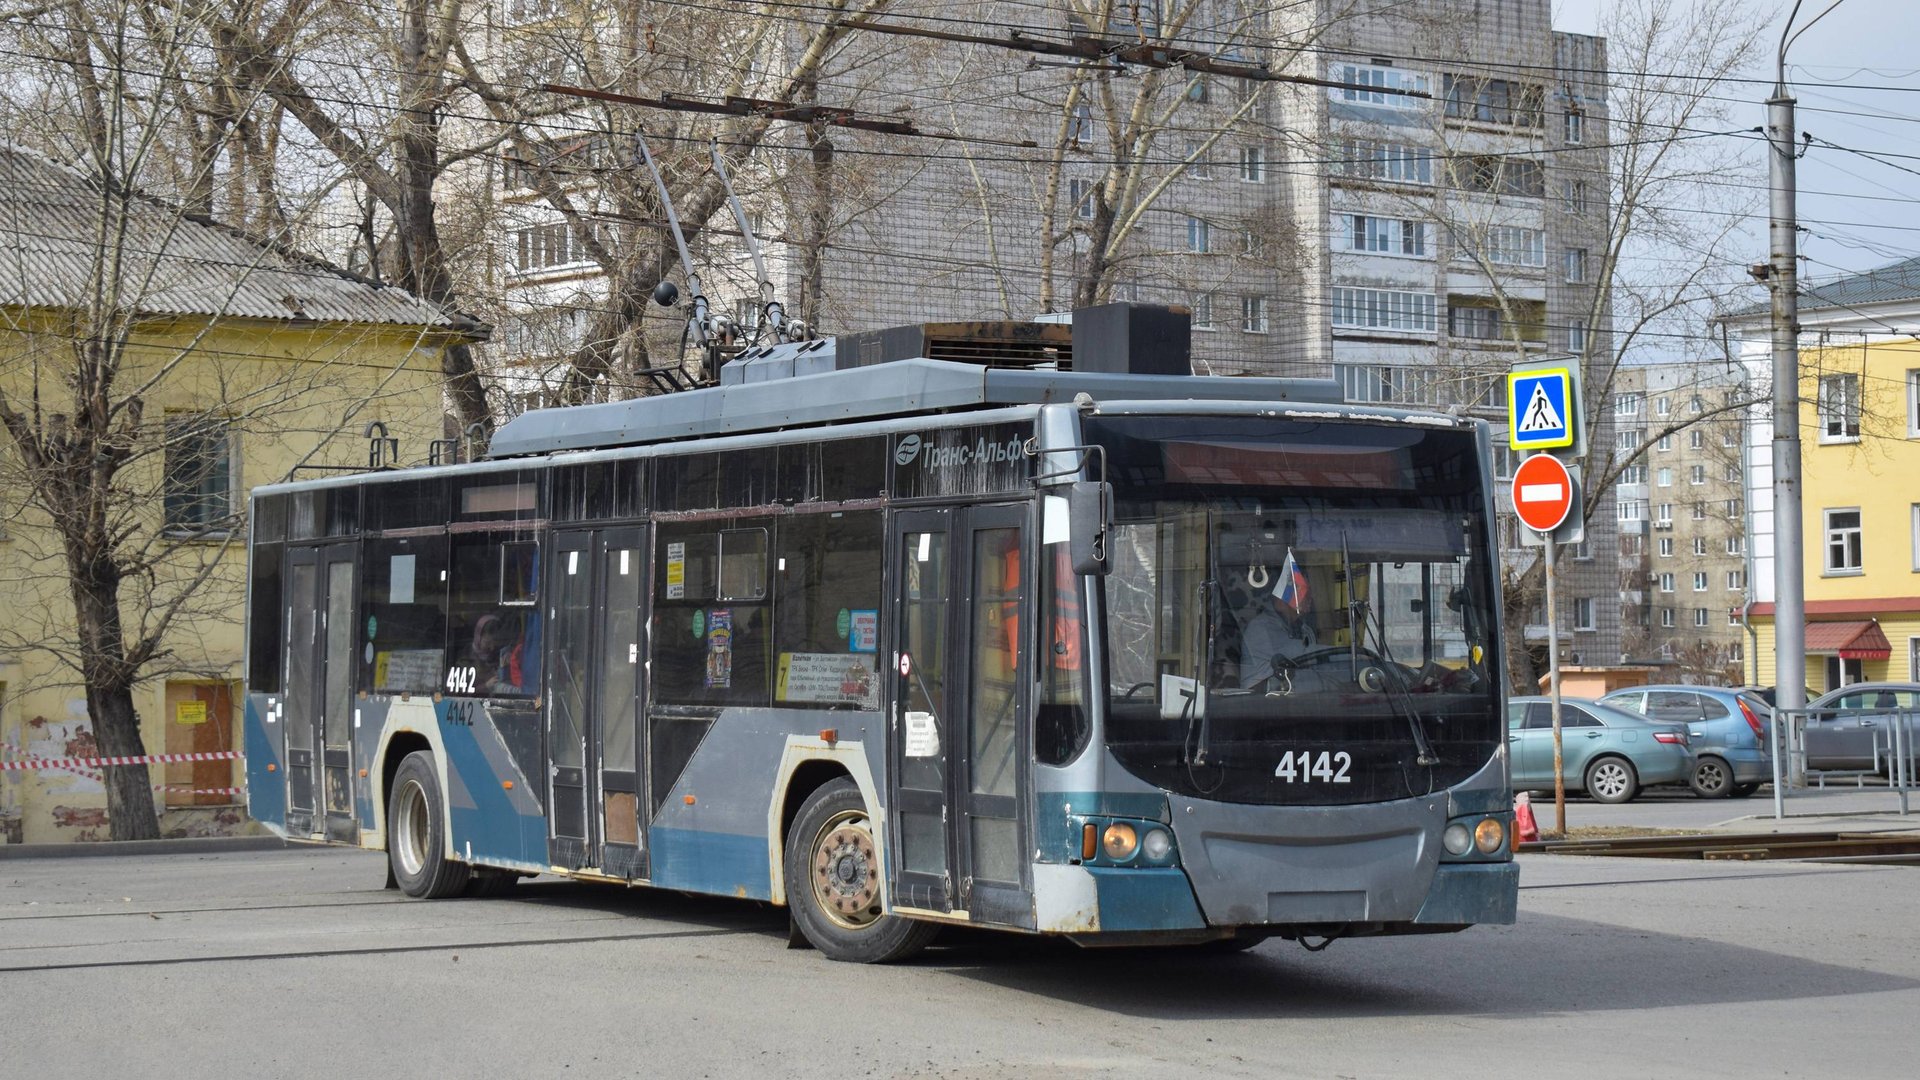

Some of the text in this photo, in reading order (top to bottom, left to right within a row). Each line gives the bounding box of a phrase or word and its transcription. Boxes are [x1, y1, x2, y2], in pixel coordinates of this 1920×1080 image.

[446, 666, 476, 693] 4142
[780, 667, 787, 687] 7
[446, 700, 474, 726] 4142
[1179, 688, 1197, 720] 7
[1275, 751, 1352, 783] 4142
